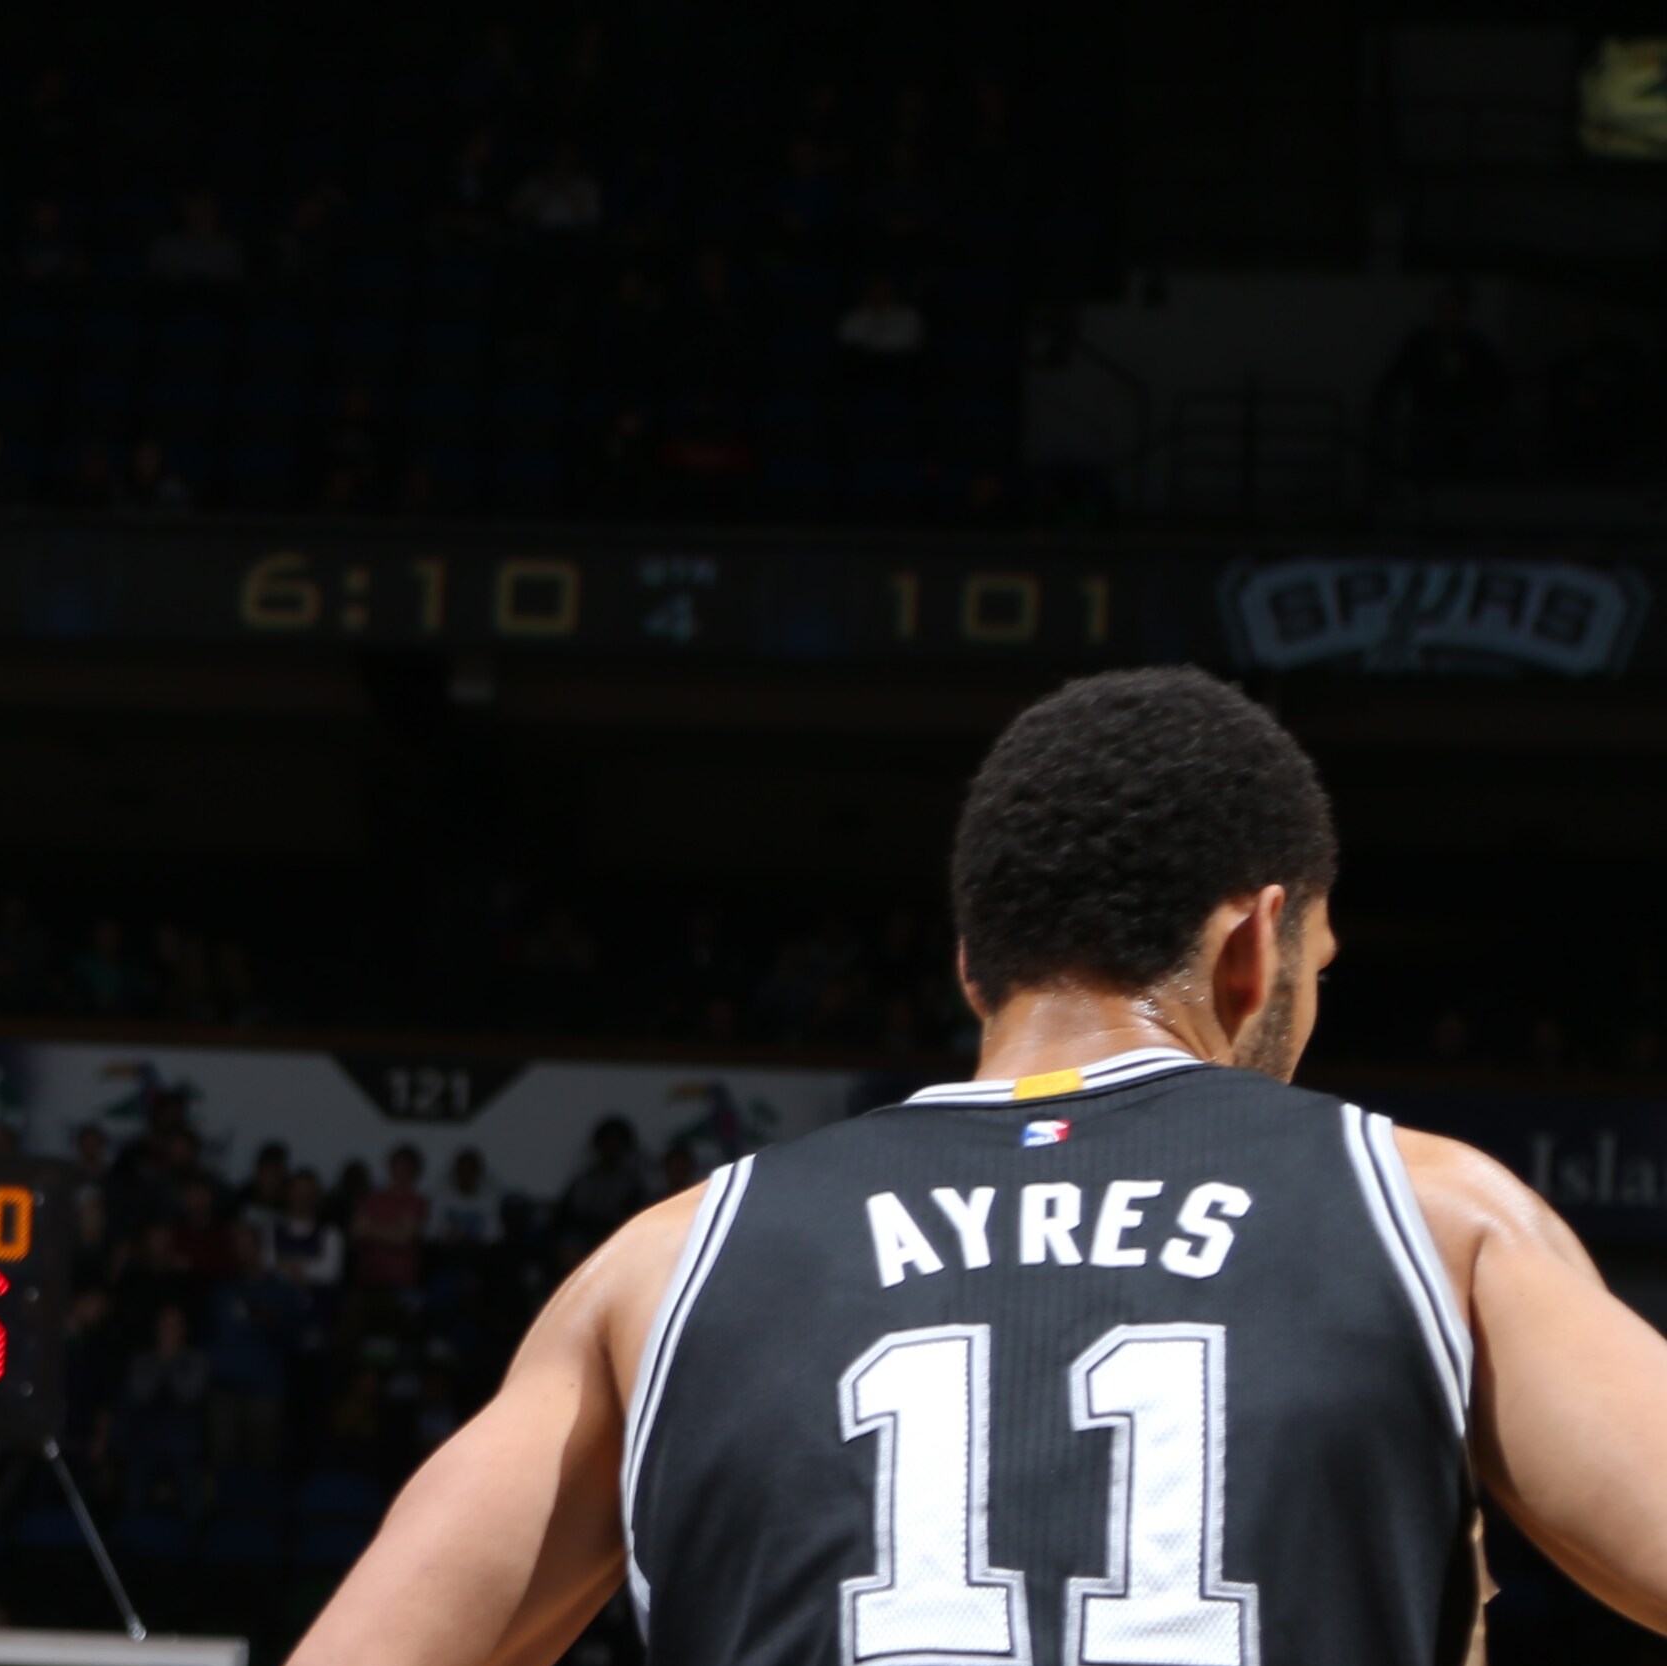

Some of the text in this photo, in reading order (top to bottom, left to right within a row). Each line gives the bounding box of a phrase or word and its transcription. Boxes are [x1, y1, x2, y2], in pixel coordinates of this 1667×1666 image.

[239, 550, 582, 638] 6:10
[888, 569, 1112, 647] 101
[386, 1067, 470, 1116] 121
[1529, 1128, 1667, 1207] Isla
[866, 1179, 1252, 1289] AYRES
